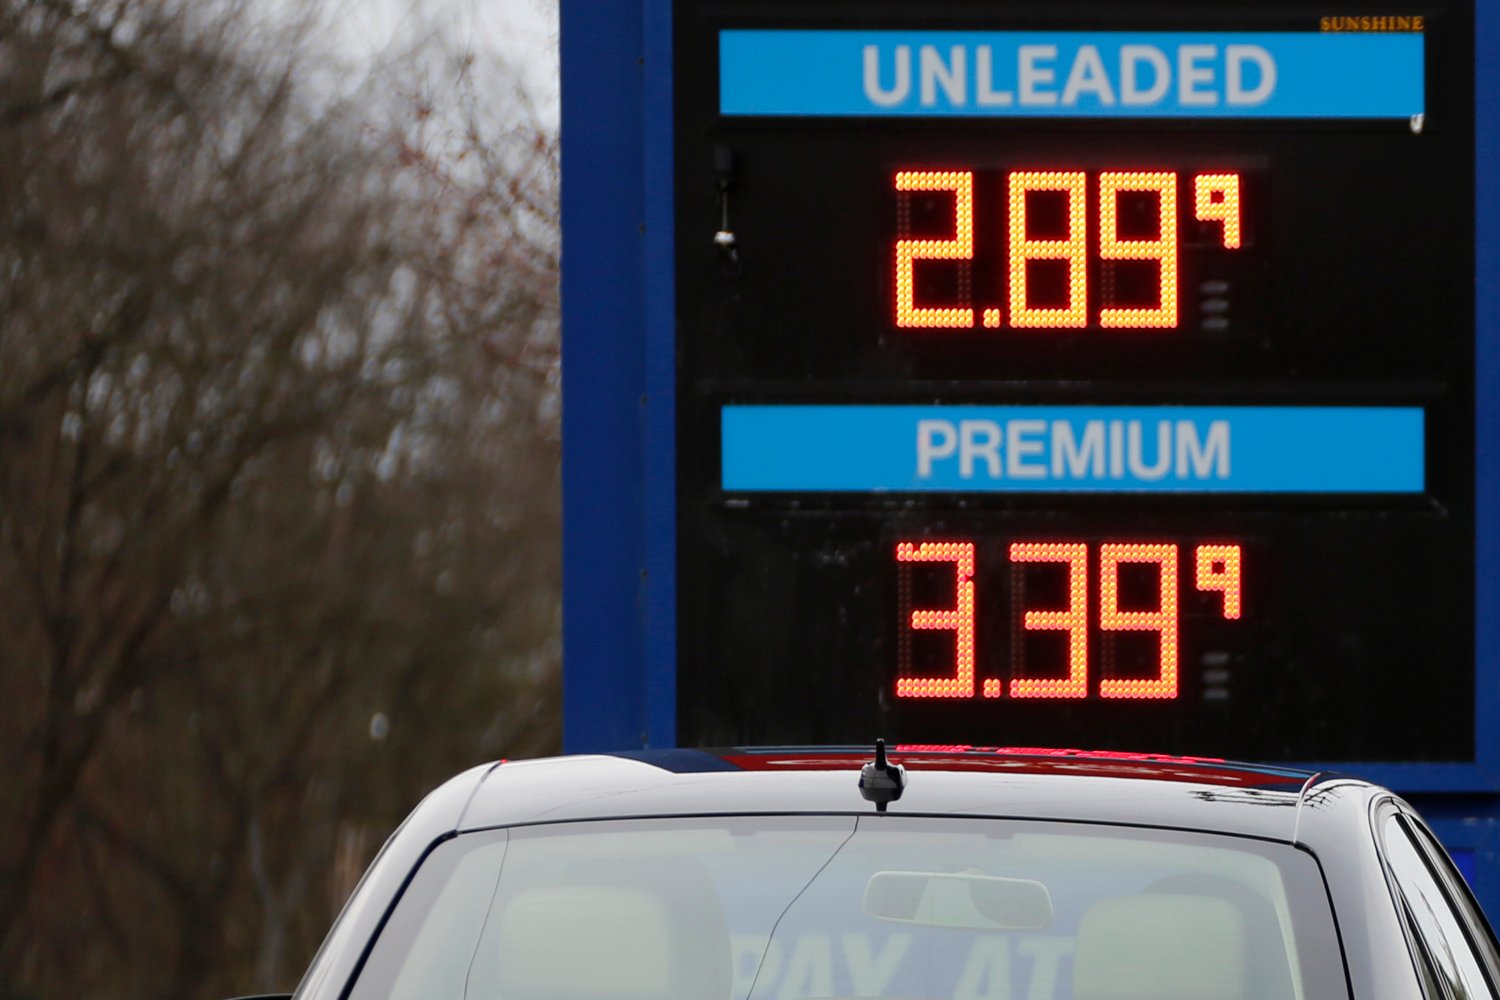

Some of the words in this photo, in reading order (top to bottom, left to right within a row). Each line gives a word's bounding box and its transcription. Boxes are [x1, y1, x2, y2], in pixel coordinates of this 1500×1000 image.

[1320, 16, 1424, 31] SUNSHINE
[862, 44, 1278, 106] UNLEADED
[916, 419, 1231, 479] PREMIUM
